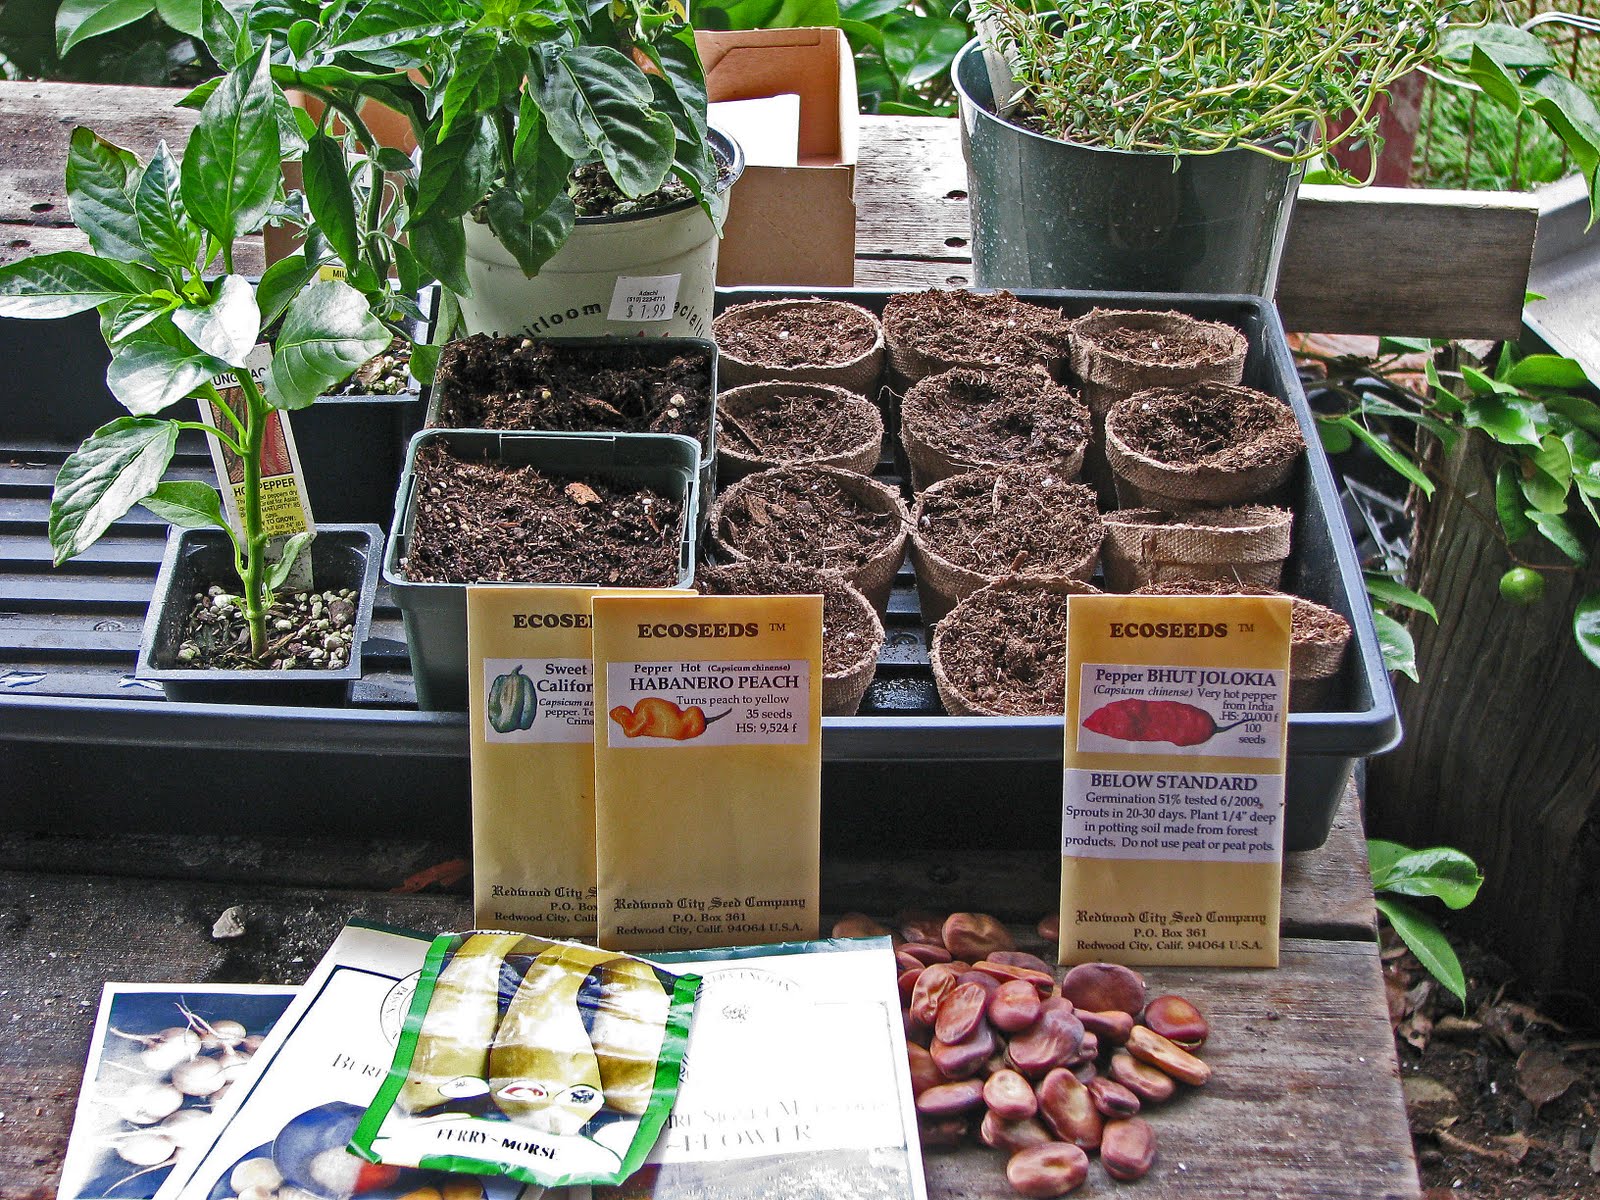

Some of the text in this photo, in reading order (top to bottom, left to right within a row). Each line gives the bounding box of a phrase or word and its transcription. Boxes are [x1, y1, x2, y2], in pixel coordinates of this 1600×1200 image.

[626, 304, 666, 319] $ 1.99
[212, 372, 238, 386] UNG
[637, 623, 786, 639] ECOSEEDS TM
[1110, 623, 1254, 639] ECOSEEDS TM
[545, 663, 587, 675] Sweet
[634, 663, 791, 675] Pepper Hot (Capsicum chinense)
[630, 675, 799, 691] HABANERO PEACH
[1096, 668, 1277, 688] Pepper BHUT JOLOKIA
[1093, 684, 1193, 697] (Capsicum chinense)
[1197, 688, 1278, 702] Very hot pepper
[538, 698, 582, 708] Capsicum
[676, 694, 789, 709] Turns peach to yellow
[1222, 700, 1274, 711] from India
[545, 709, 580, 719] pepper.
[746, 709, 792, 719] 35 seeds
[1274, 713, 1279, 722] f
[736, 723, 798, 734] HS: 9,524 f
[1244, 723, 1262, 733] 100
[1238, 735, 1266, 744] seeds
[1090, 773, 1258, 791] BELOW STANDARD
[1085, 791, 1155, 804] Germination
[1158, 793, 1181, 806] 51%
[1184, 795, 1217, 805] tested
[1066, 805, 1277, 825] Sprouts in 20-30 days. Plant 1/4" deep
[1084, 821, 1258, 836] in potting soil made from forest
[1065, 835, 1116, 847] products.
[1121, 837, 1138, 847] Do
[1140, 838, 1158, 848] not
[1182, 840, 1205, 851] peat
[1207, 842, 1221, 850] or
[1222, 841, 1247, 853] peat
[1248, 842, 1275, 854] pots.
[491, 884, 551, 898] Redwood
[554, 886, 583, 900] City
[550, 902, 574, 911] P.O.
[613, 896, 806, 912] Redwood City Seed Company
[494, 911, 542, 922] Redwood
[546, 913, 570, 923] City,
[672, 913, 746, 923] P.O. Box 361
[1075, 910, 1267, 926] Redwood City Seed Company
[616, 923, 804, 936] Redwood City, Calif. 94064 U.S.A.
[1133, 928, 1207, 938] P.O. Box 361
[1076, 940, 1263, 951] Redwood City, Calif. 94064 U.S.A.
